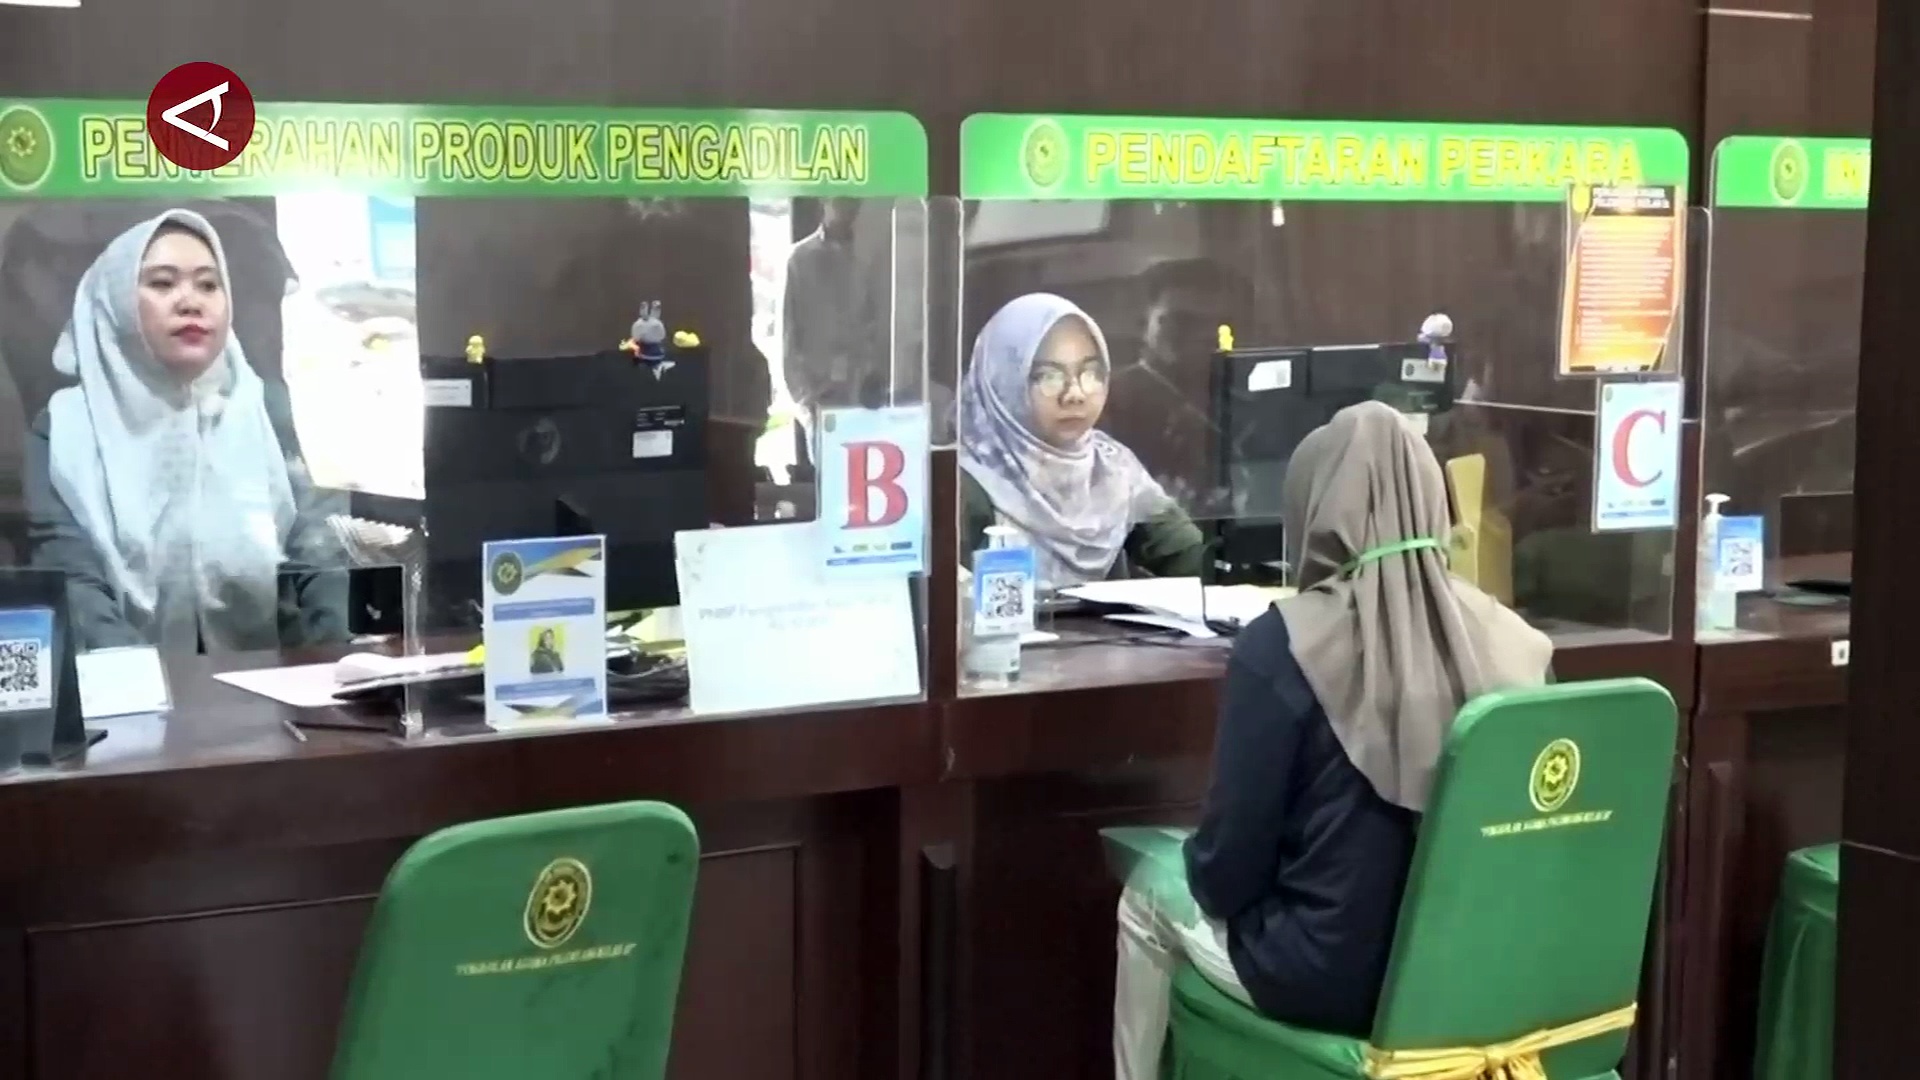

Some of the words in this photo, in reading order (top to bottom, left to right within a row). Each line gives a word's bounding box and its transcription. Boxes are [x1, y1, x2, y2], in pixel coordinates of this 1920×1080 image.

[83, 117, 400, 178] PENERAHAN
[413, 121, 598, 181] PRODUK
[607, 124, 868, 182] PENGADILAN
[1087, 132, 1425, 186] PENDAFTARAN
[1440, 138, 1642, 187] PERKARA
[1612, 409, 1666, 488] C
[840, 441, 908, 530] B
